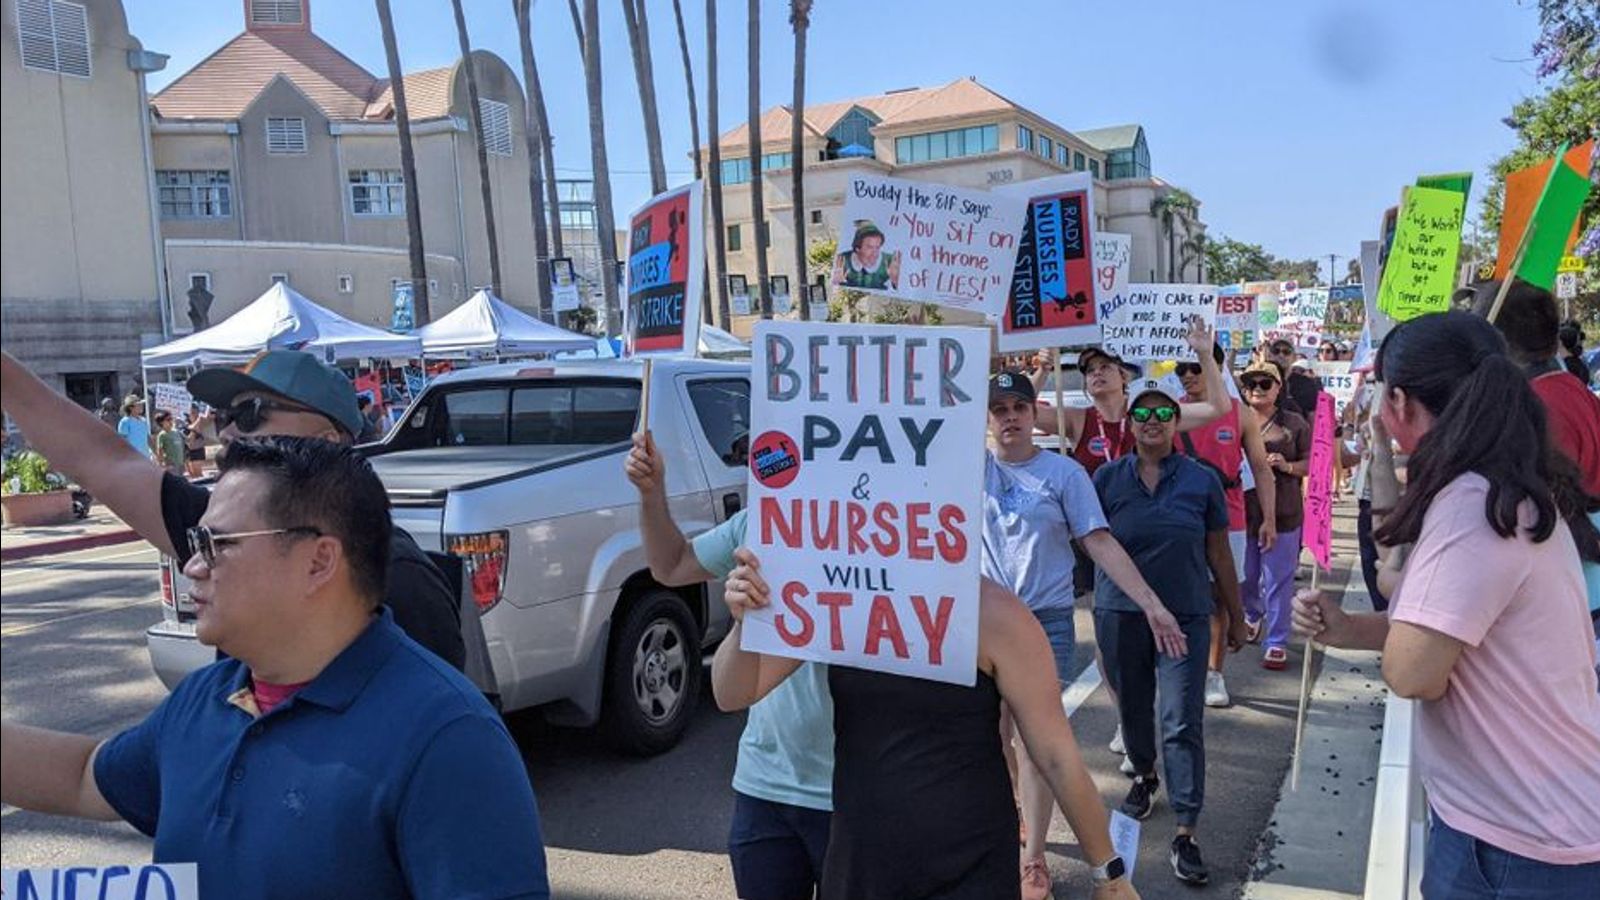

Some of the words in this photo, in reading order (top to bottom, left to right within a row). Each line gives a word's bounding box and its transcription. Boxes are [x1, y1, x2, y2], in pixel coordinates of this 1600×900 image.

[854, 180, 902, 211] Buddy
[908, 186, 931, 209] the
[989, 231, 1014, 249] on
[1037, 202, 1060, 285] NURSES
[1064, 206, 1080, 251] RADY
[911, 245, 920, 260] a
[932, 244, 989, 271] throne
[910, 269, 928, 288] of
[1013, 255, 1036, 327] STRIKE
[640, 294, 683, 330] STRIKE
[1129, 290, 1159, 306] CAN'T
[1165, 292, 1194, 306] CARE
[1132, 311, 1156, 322] KIDS
[1161, 311, 1173, 322] IF
[1111, 325, 1145, 340] CAN'T
[1149, 325, 1190, 340] AFFOR
[1215, 330, 1253, 347] RSE
[765, 333, 973, 408] BETTER
[802, 414, 945, 467] PAY
[851, 473, 871, 501] &
[759, 496, 968, 564] NURSES
[822, 563, 895, 592] WILL
[774, 580, 955, 666] STAY
